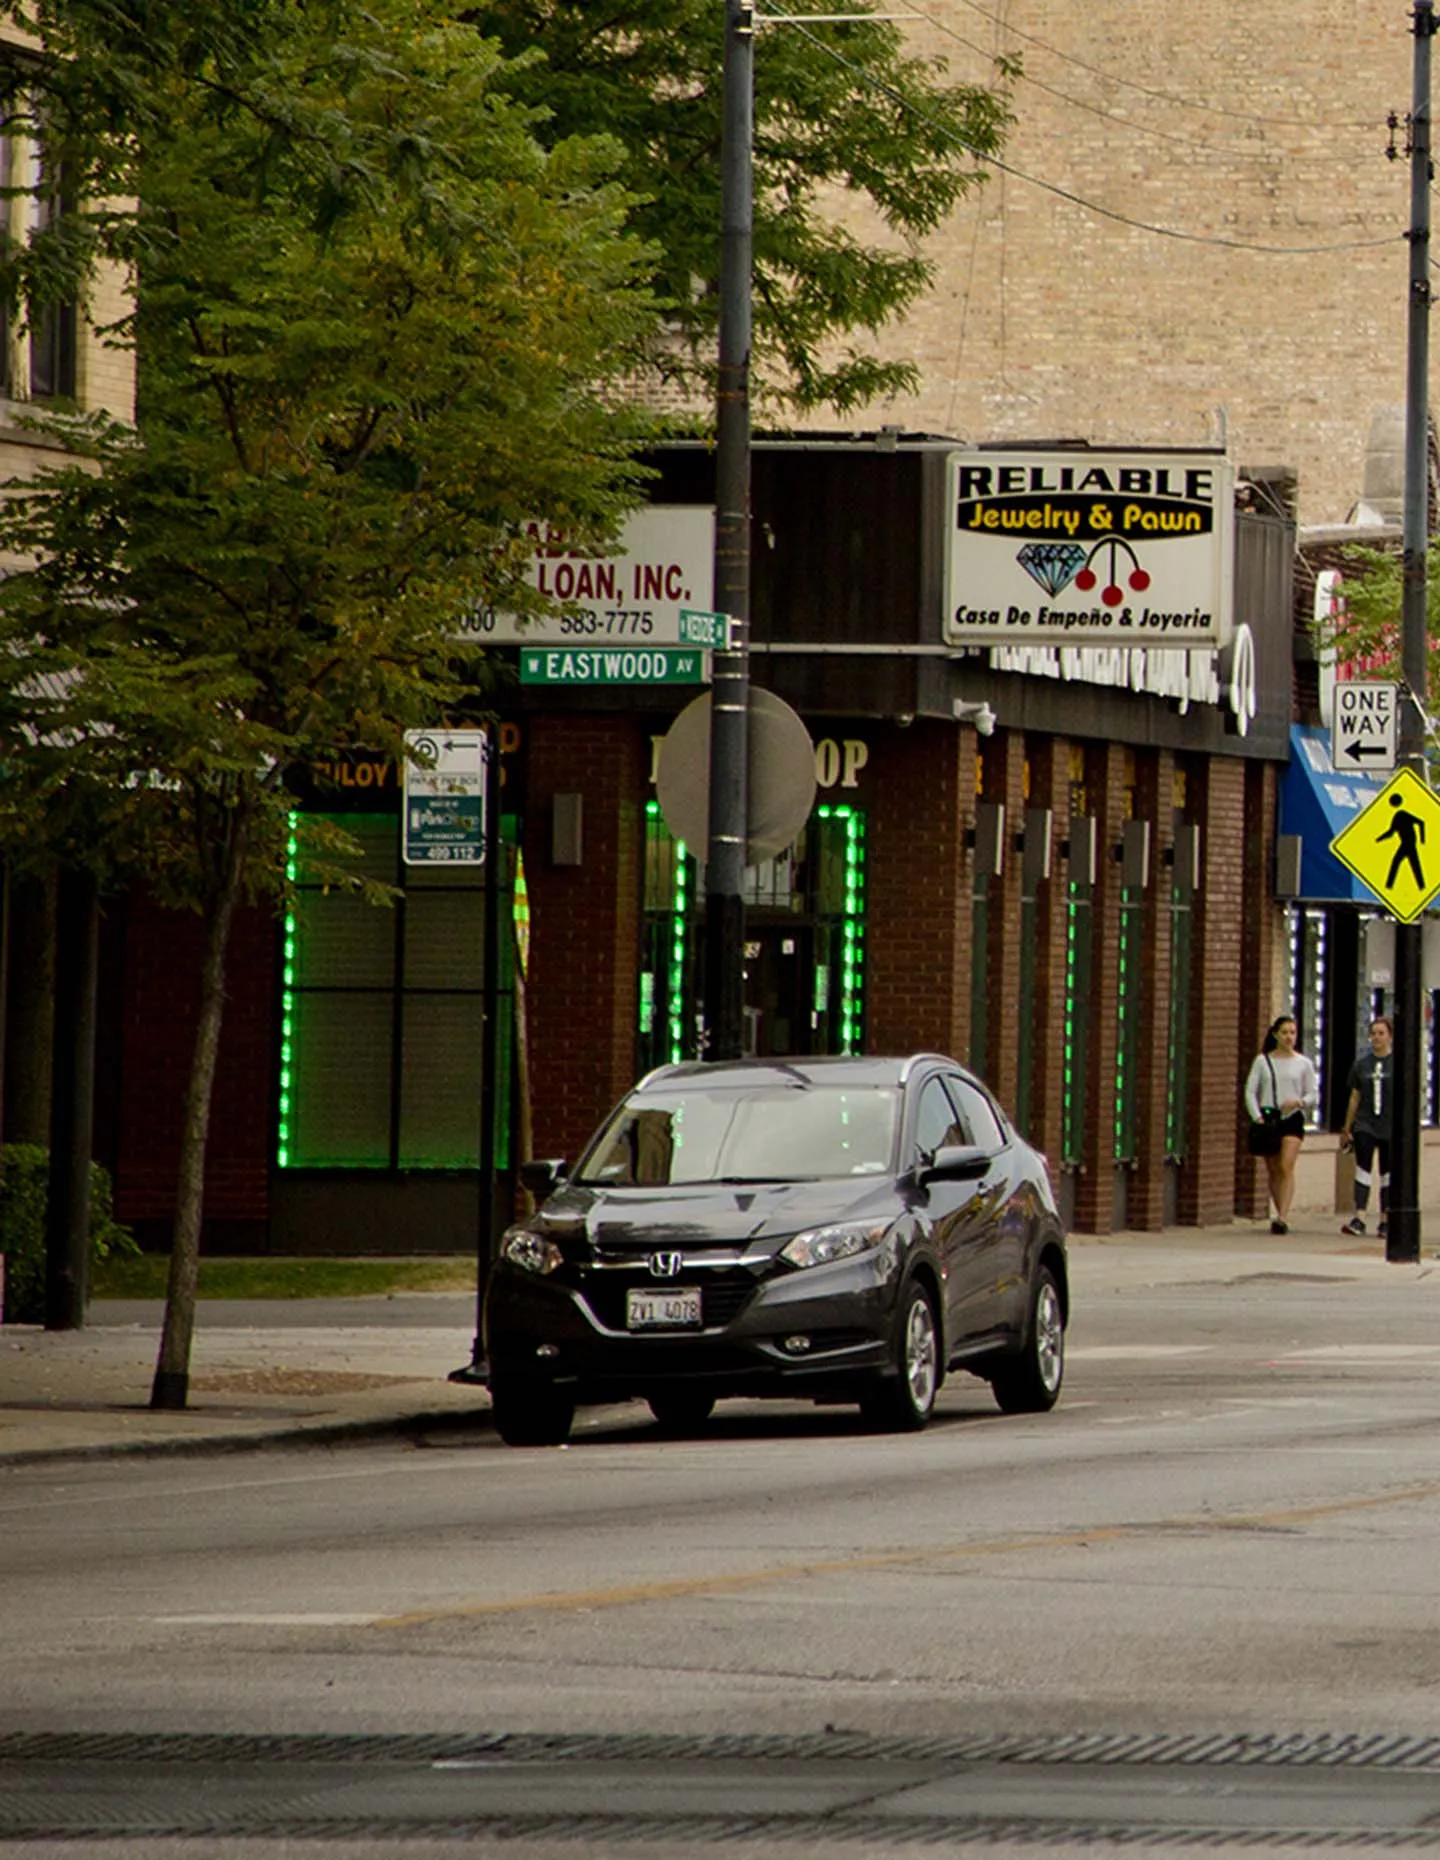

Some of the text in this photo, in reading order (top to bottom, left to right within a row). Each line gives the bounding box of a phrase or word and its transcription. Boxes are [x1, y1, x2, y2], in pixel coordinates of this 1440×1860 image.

[959, 466, 1213, 503] RELIABLE
[968, 503, 1202, 535] Jewelry & Pawn
[538, 564, 691, 607] LOAN, INC.
[560, 611, 654, 634] 583-7775
[955, 606, 1212, 631] Casa De Empeño & Joyeria
[547, 654, 667, 678] EASTWOOD
[676, 659, 694, 673] AV
[1342, 690, 1389, 711] ONE
[1340, 715, 1390, 735] WAY
[815, 738, 869, 788] OP
